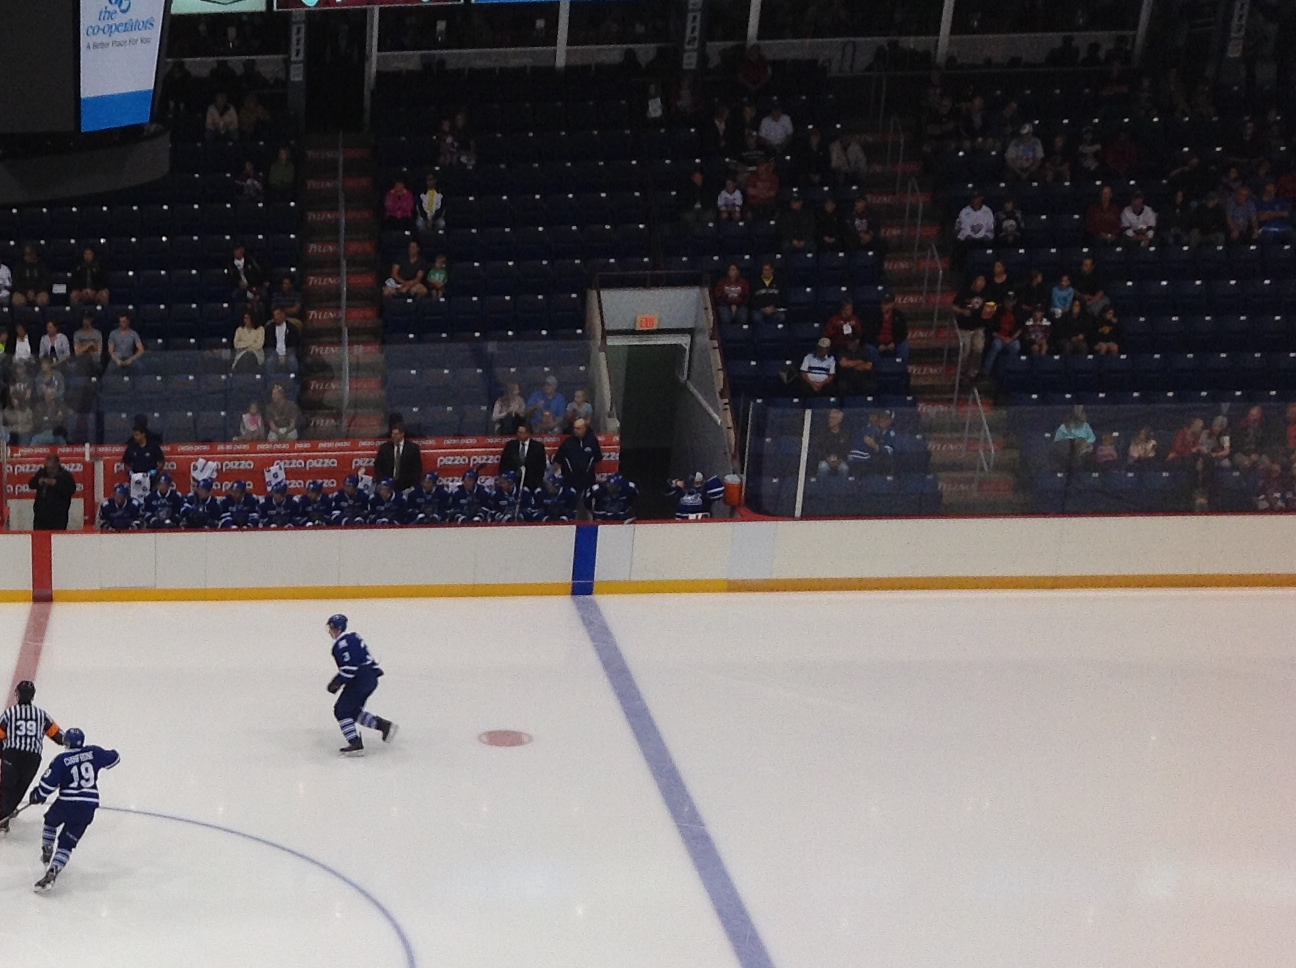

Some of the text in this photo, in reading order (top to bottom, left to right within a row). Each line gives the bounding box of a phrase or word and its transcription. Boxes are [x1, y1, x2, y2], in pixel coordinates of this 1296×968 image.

[99, 6, 117, 21] the
[85, 17, 155, 37] co-operators
[223, 461, 254, 472] pizza
[306, 459, 338, 470] pizza
[352, 458, 375, 469] pizz
[437, 455, 502, 467] pizza pizza
[15, 720, 37, 735] 39
[68, 761, 95, 787] 19
